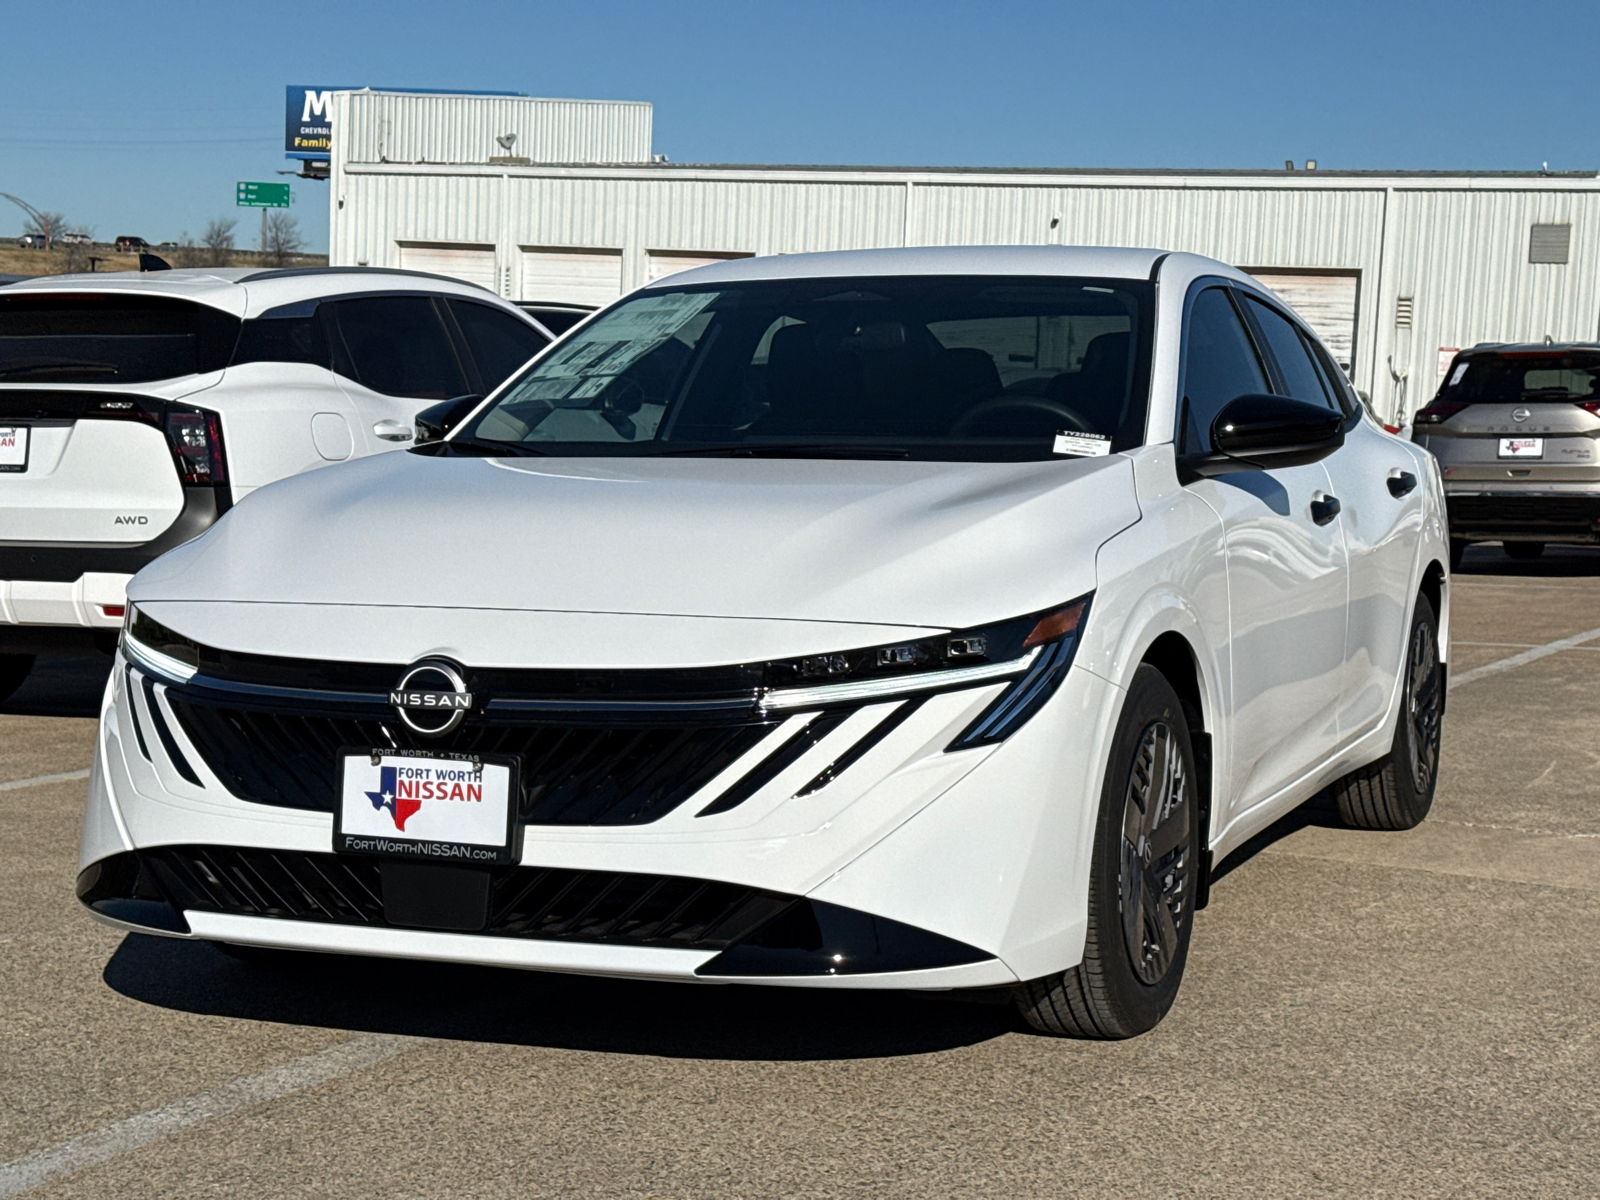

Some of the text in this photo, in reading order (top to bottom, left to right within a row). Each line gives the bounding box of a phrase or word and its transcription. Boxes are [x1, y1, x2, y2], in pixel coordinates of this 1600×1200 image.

[300, 127, 332, 135] CHEVROL
[294, 137, 332, 149] Family
[114, 516, 148, 525] AWD
[390, 692, 469, 707] NISSAN
[372, 748, 480, 762] FORT WORTH TEXAS
[398, 767, 482, 783] FORT WORTH
[398, 780, 482, 802] NISSAN
